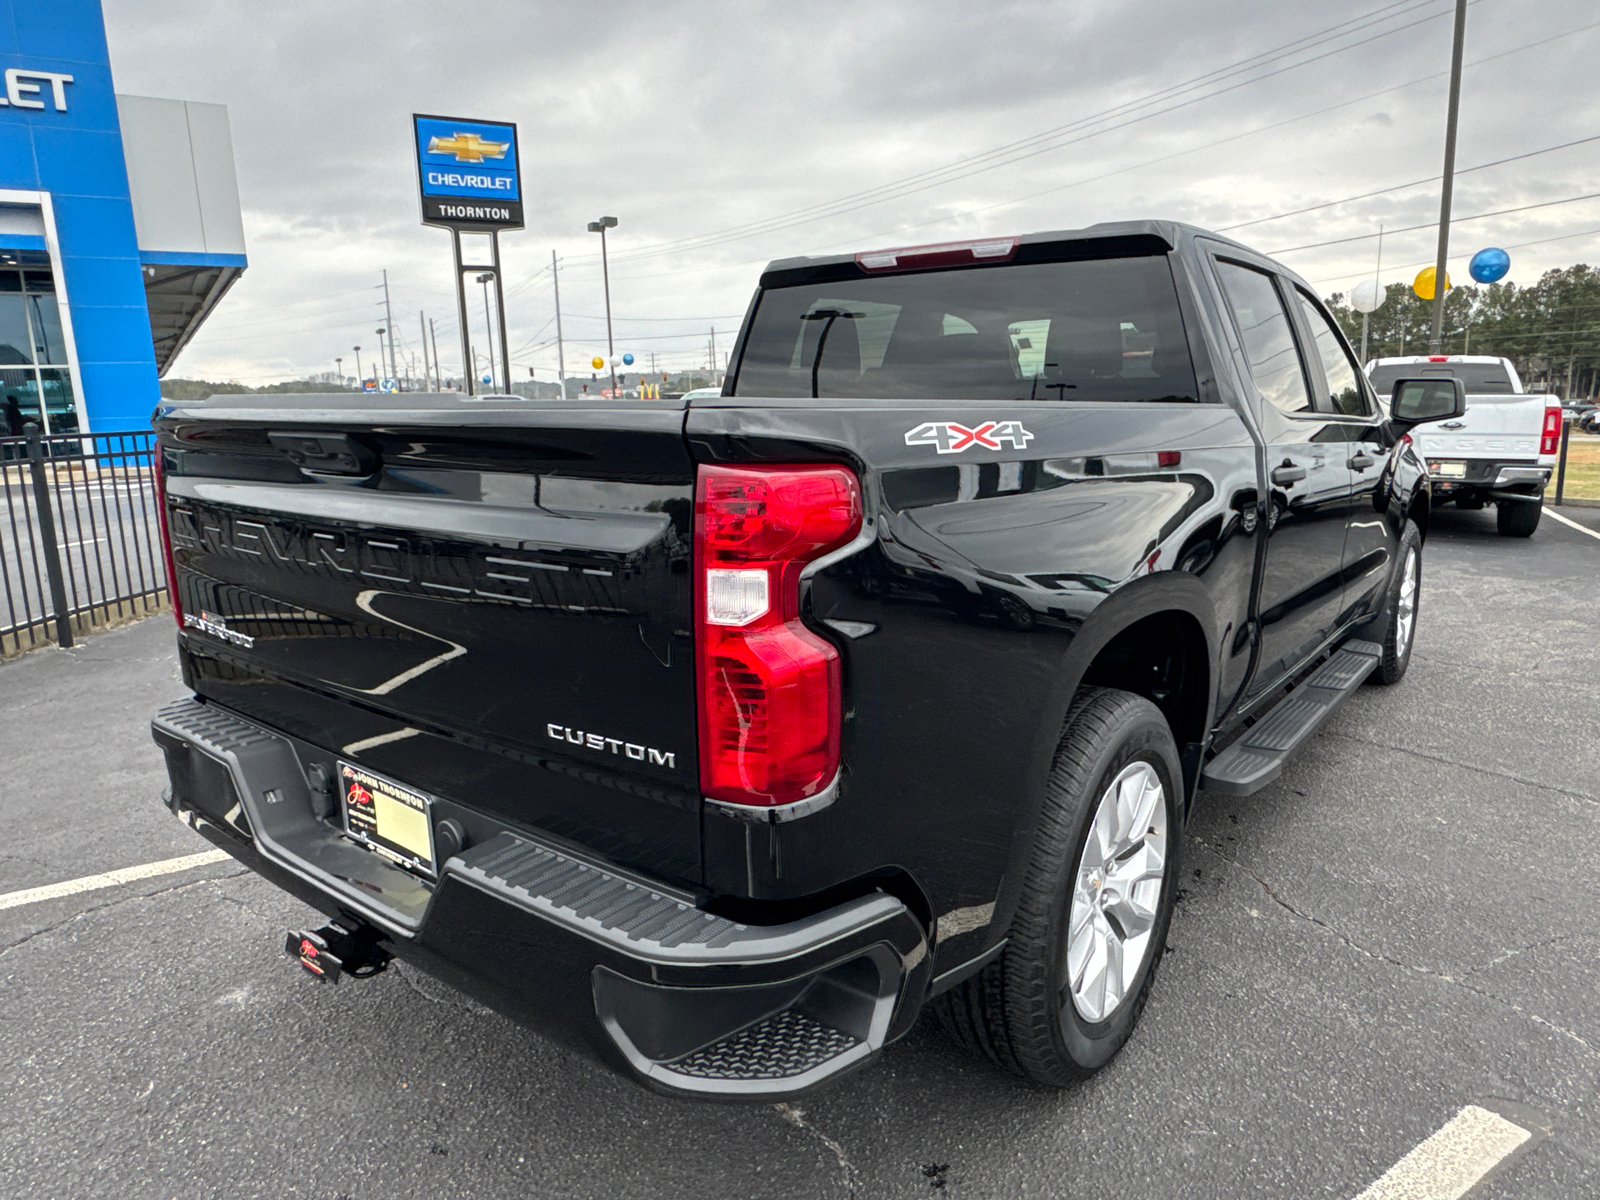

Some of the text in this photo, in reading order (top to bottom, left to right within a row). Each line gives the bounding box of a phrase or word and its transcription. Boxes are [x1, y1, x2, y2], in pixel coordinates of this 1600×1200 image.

[428, 172, 513, 190] CHEVROLET
[438, 204, 510, 220] THORNTON
[174, 507, 614, 611] CHEVROLET
[546, 722, 676, 769] CUSTOM
[356, 772, 379, 789] JOHN
[379, 781, 424, 810] THORNTON
